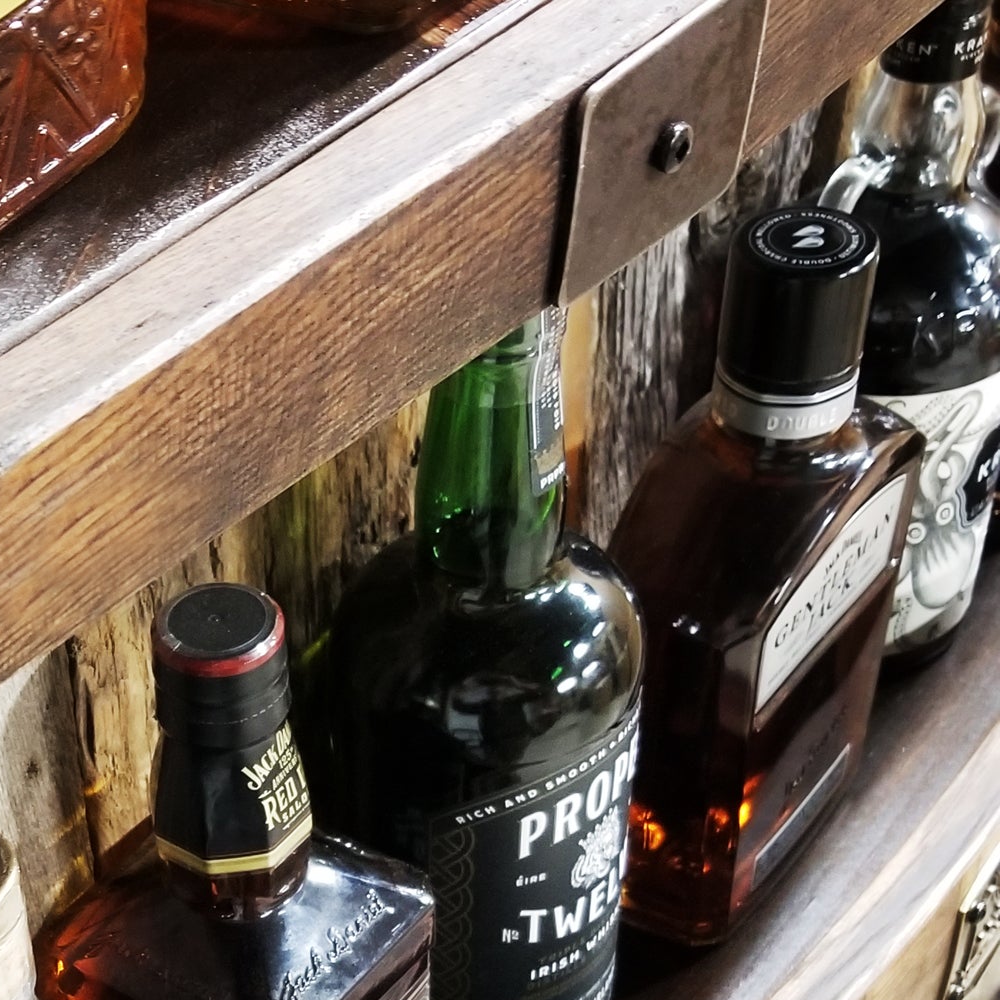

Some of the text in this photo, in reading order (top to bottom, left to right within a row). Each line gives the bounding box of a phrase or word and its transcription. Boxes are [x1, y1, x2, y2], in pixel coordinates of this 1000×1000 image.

[241, 743, 280, 791] JACK
[455, 805, 497, 825] RICH
[504, 788, 538, 809] AND
[545, 747, 607, 792] SMOOTH
[260, 776, 299, 832] RED
[530, 949, 580, 981] IRISH
